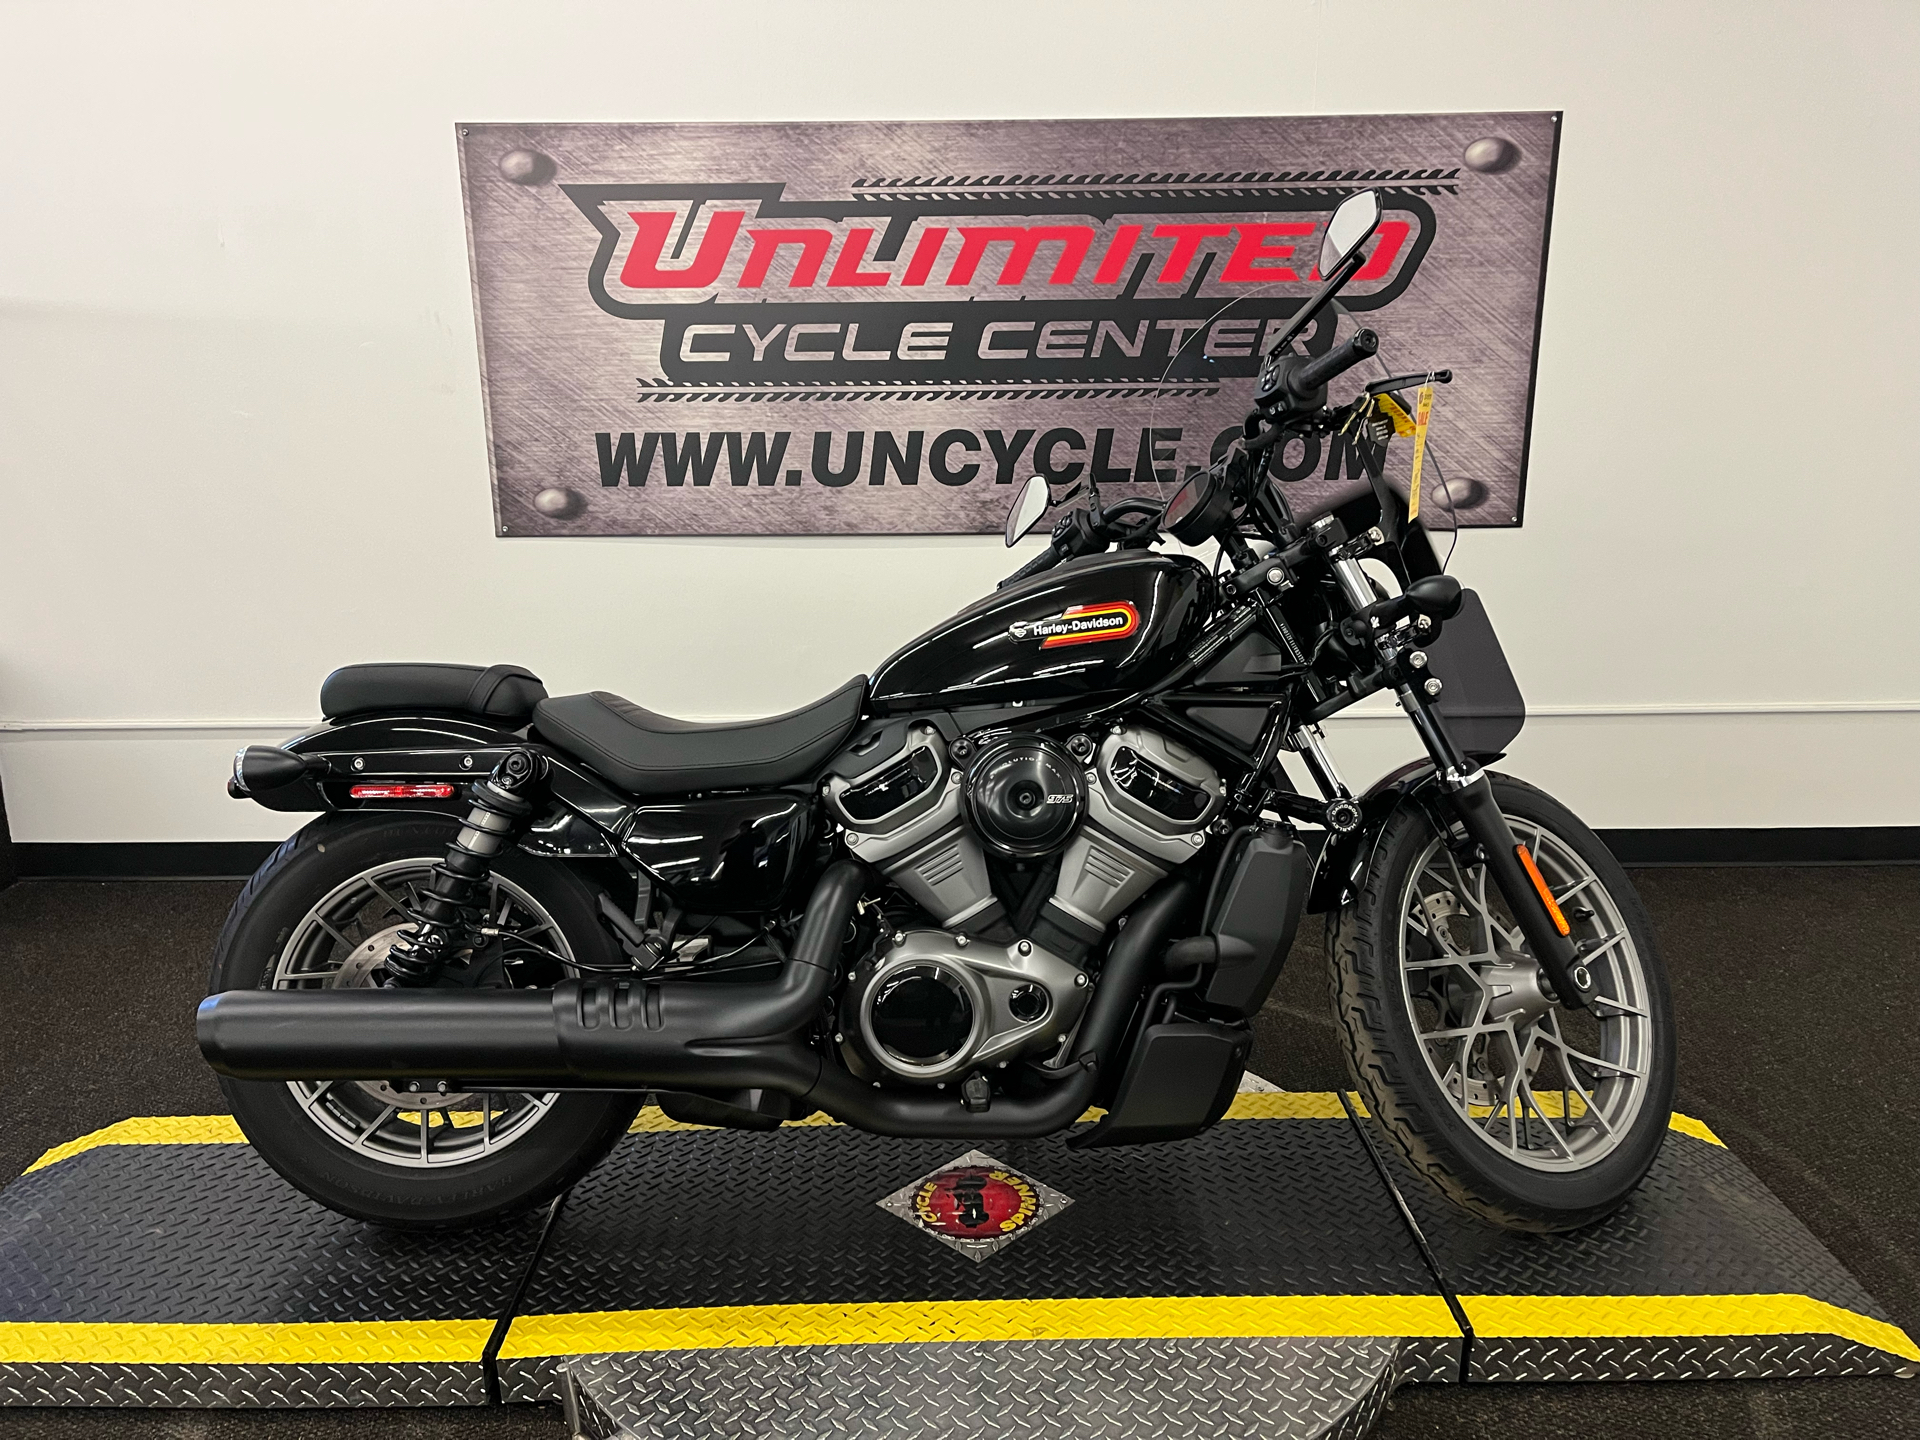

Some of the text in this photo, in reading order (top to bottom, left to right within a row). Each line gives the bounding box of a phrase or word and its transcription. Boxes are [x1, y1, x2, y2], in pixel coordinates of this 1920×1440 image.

[620, 210, 1411, 288] UNLIMITED
[679, 319, 1318, 362] CYCLE CENTER
[1033, 616, 1124, 636] Harley-Davidson
[916, 1181, 938, 1223] CYCLE
[988, 1170, 1037, 1232] SPINNER
